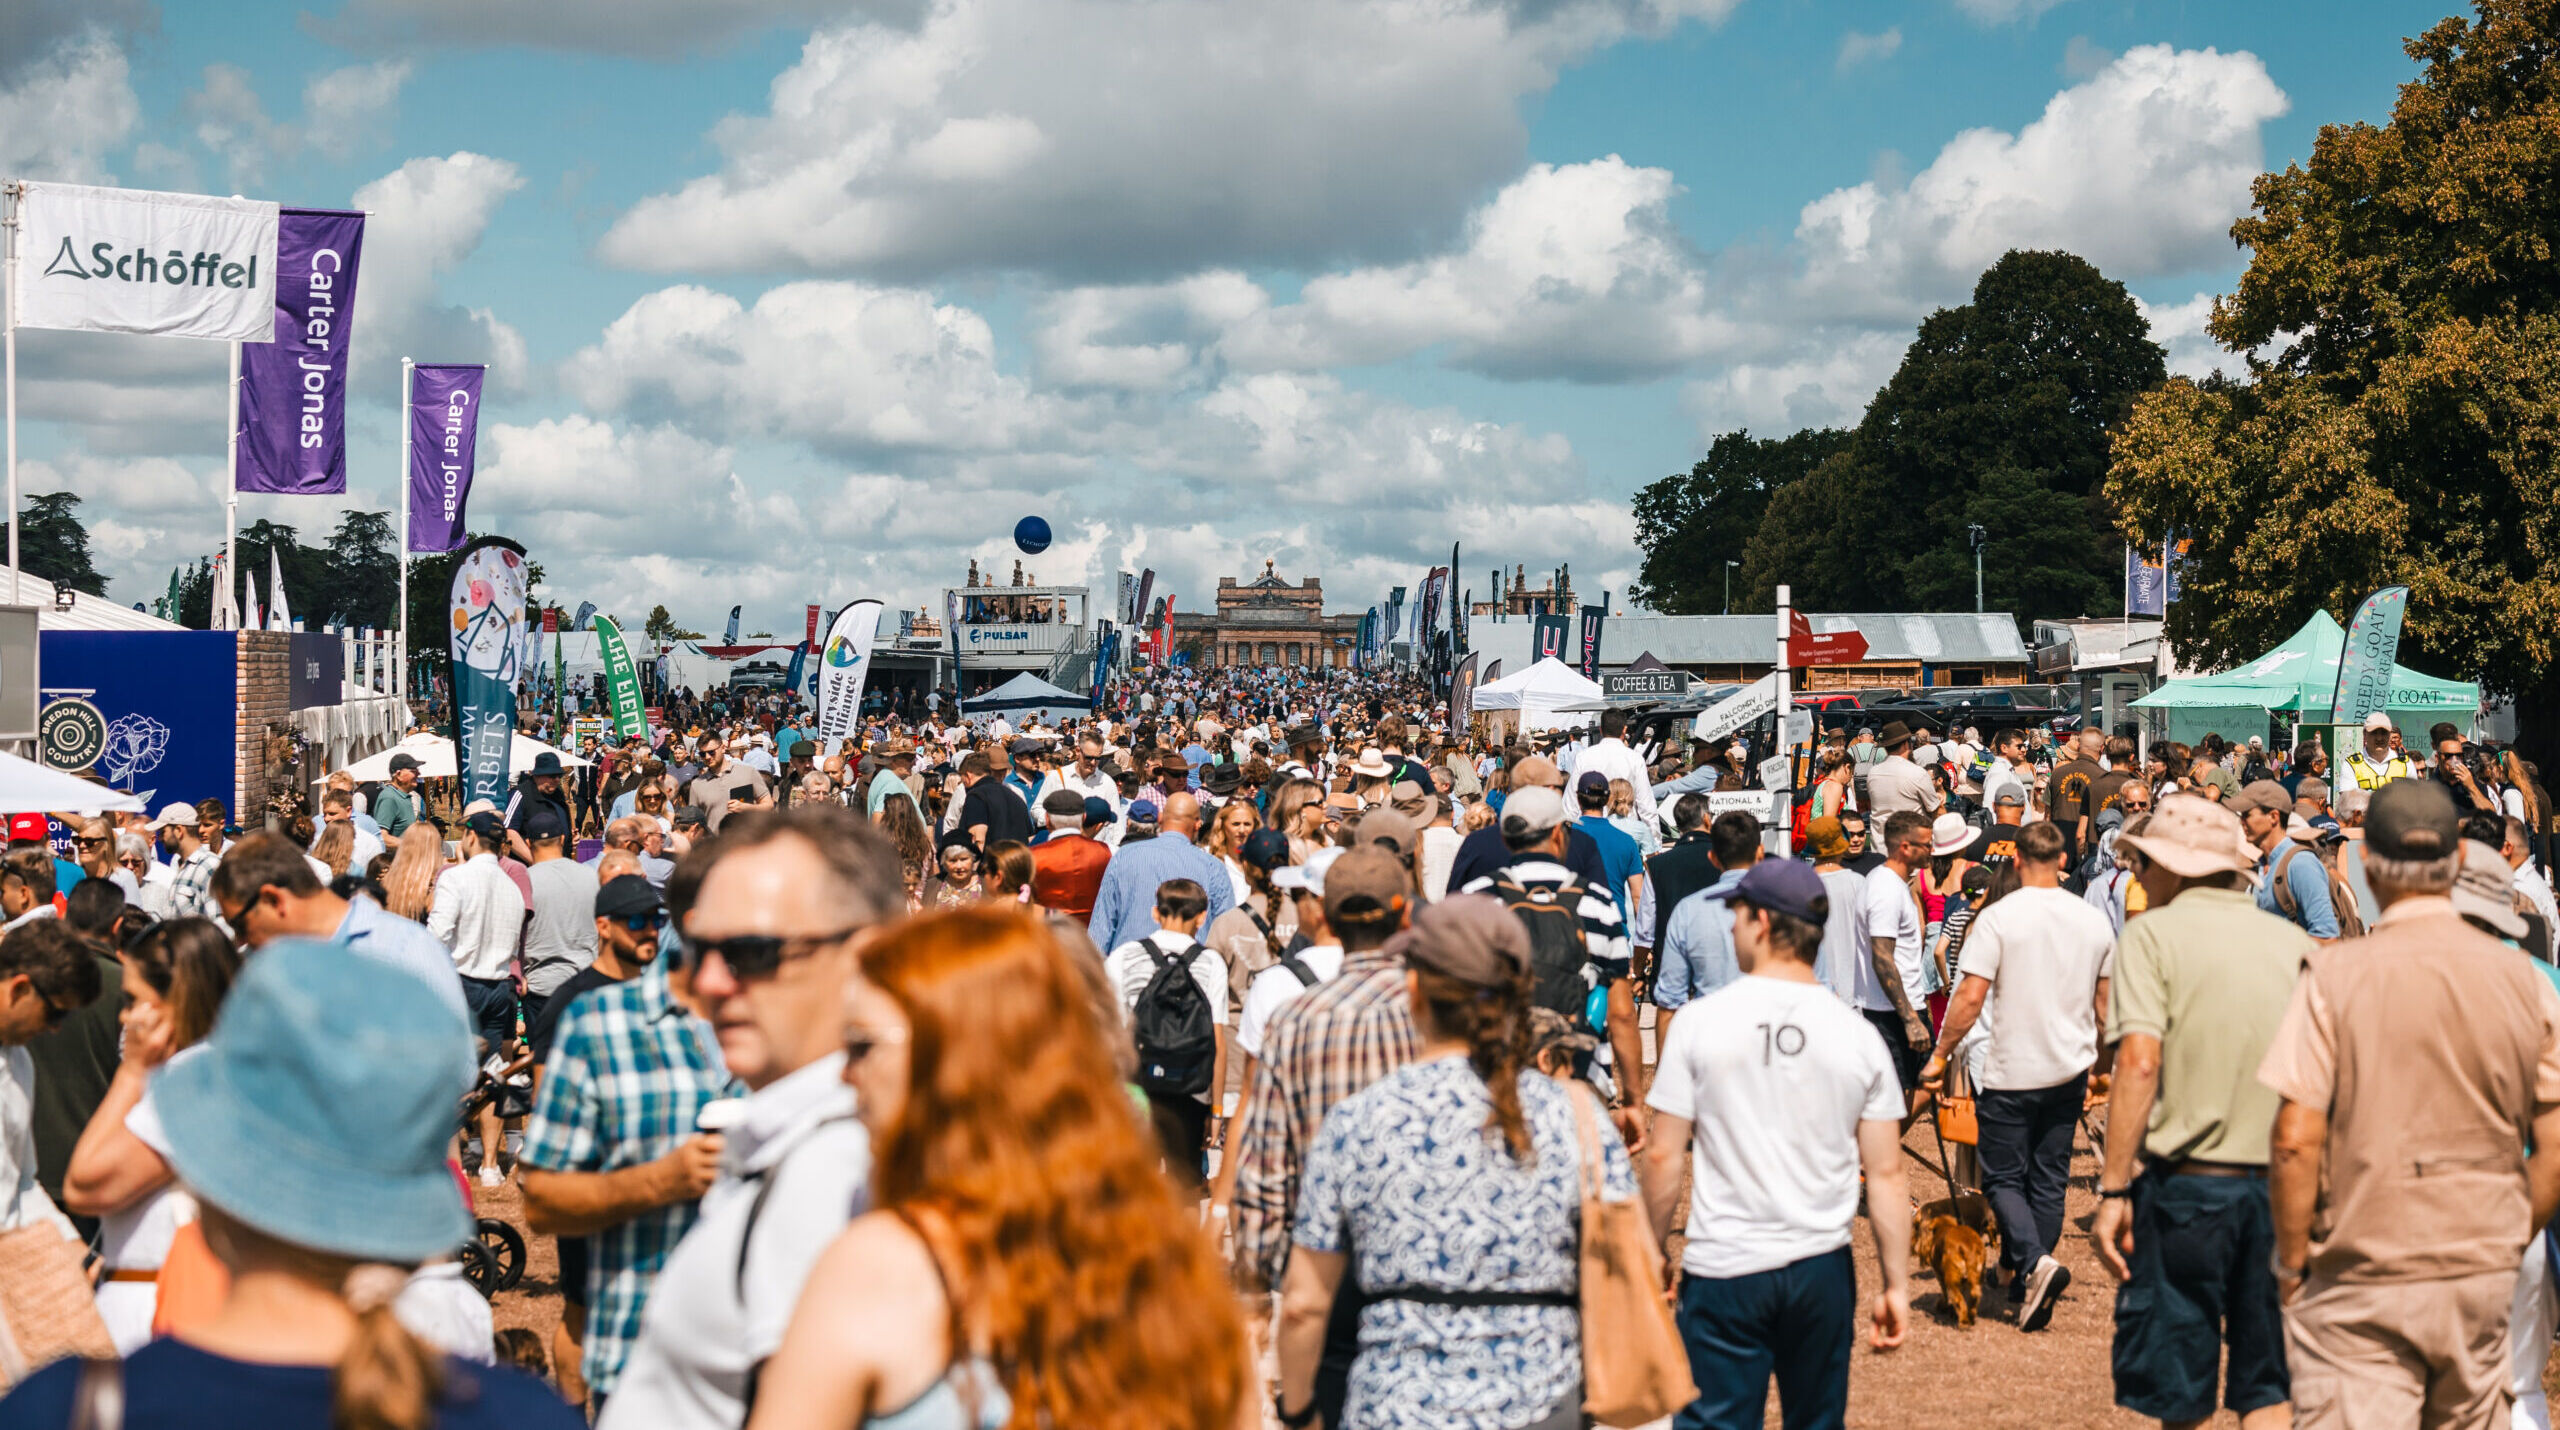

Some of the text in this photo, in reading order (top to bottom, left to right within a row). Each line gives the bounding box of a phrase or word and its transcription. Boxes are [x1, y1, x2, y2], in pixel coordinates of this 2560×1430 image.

[298, 247, 342, 449] Carter Jonas
[441, 389, 470, 523] Carter Jonas
[984, 631, 1028, 640] PULSAR
[1583, 615, 1598, 680] MC
[2354, 608, 2386, 724] REEDY GOAT
[2377, 634, 2396, 686] CREAM
[1611, 675, 1676, 692] COFFEE & TEA
[2398, 690, 2441, 704] GOAT
[832, 676, 857, 740] Alliance
[1719, 696, 1757, 721] FALCONRY
[2372, 689, 2387, 714] ICE
[41, 707, 97, 735] BREDON HILL
[1704, 722, 1730, 740] HORSE
[1731, 718, 1738, 726] &
[1738, 703, 1764, 722] HOUND
[46, 742, 96, 764] COUNTRY
[1756, 796, 1762, 804] &
[1756, 1023, 1806, 1067] 10
